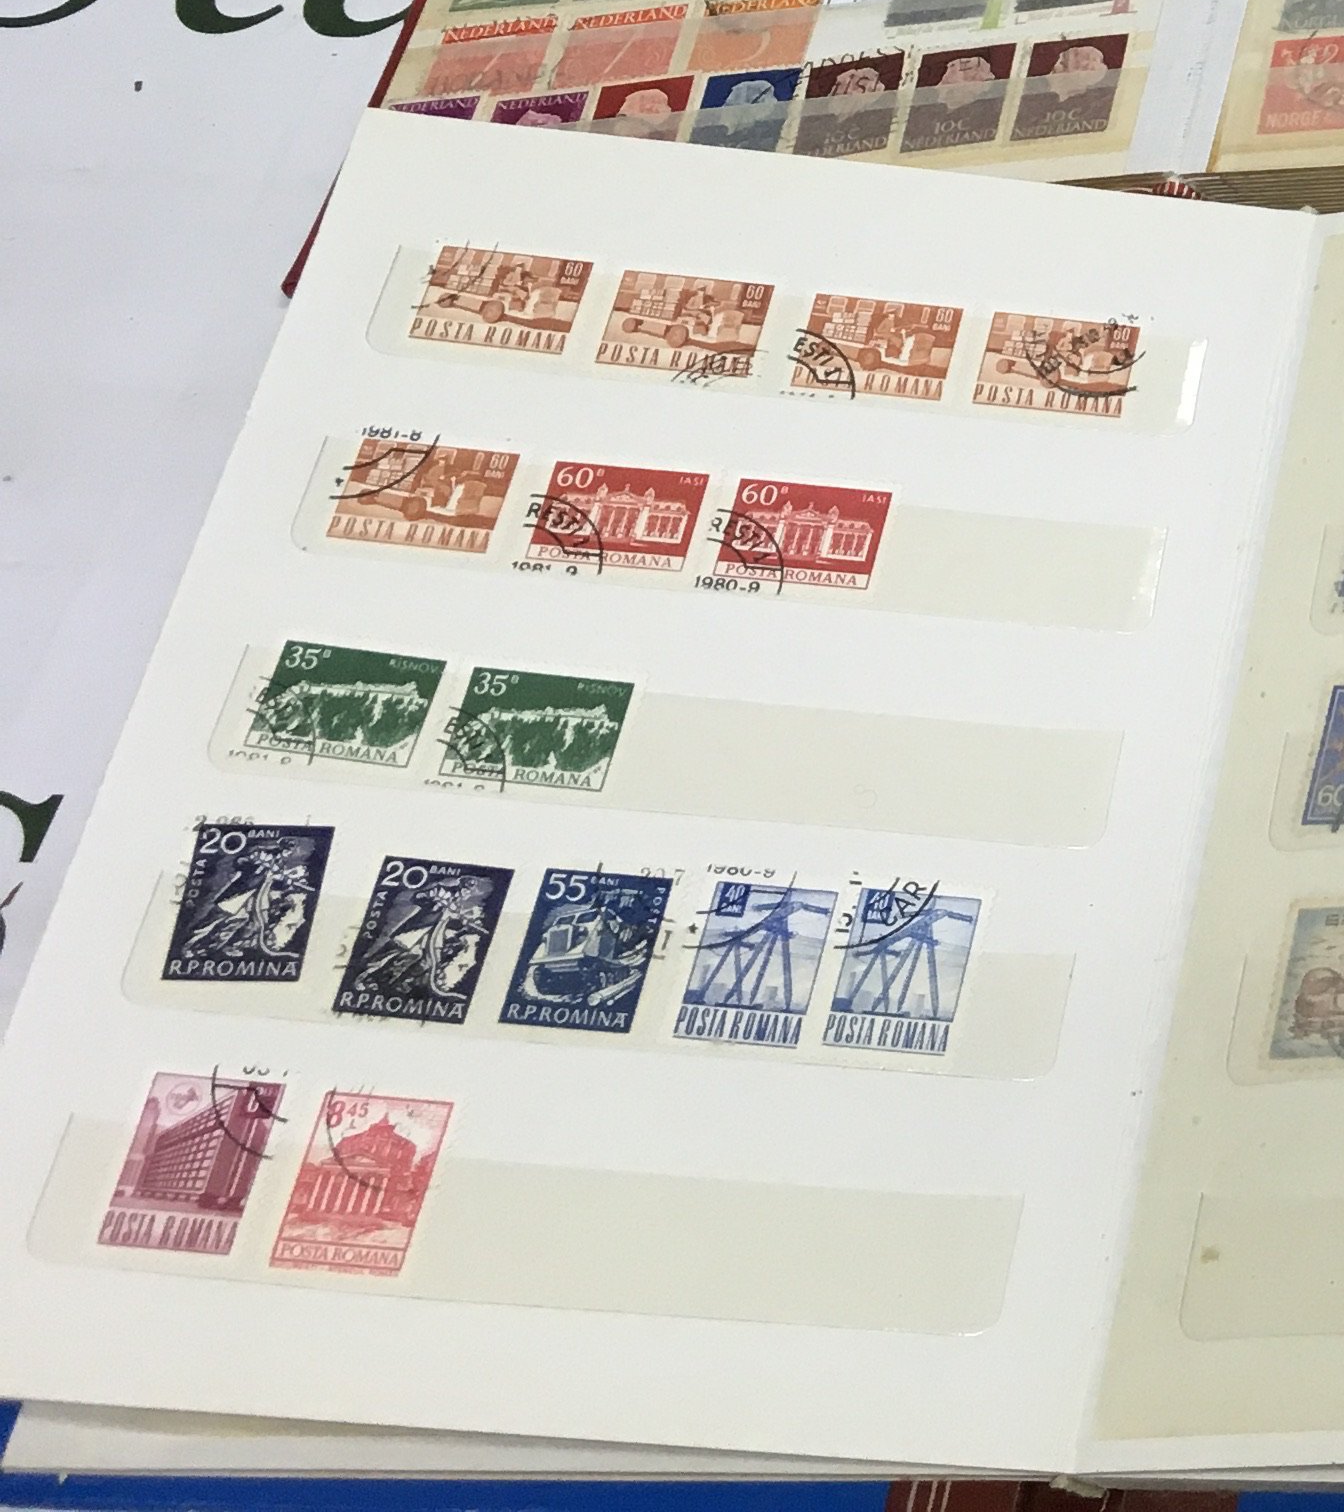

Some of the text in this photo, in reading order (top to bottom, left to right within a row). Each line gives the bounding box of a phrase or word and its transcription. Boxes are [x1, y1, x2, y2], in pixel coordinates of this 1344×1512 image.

[444, 17, 558, 44] NEDERLAND
[497, 92, 588, 112] NEDERLAND
[410, 318, 567, 353] POSTA ROMANA
[785, 569, 858, 587] ROMANA
[200, 828, 248, 856] 20
[381, 861, 461, 889] 20 BANI
[545, 873, 589, 901] 55
[824, 1013, 950, 1053] POSTA ROMANA
